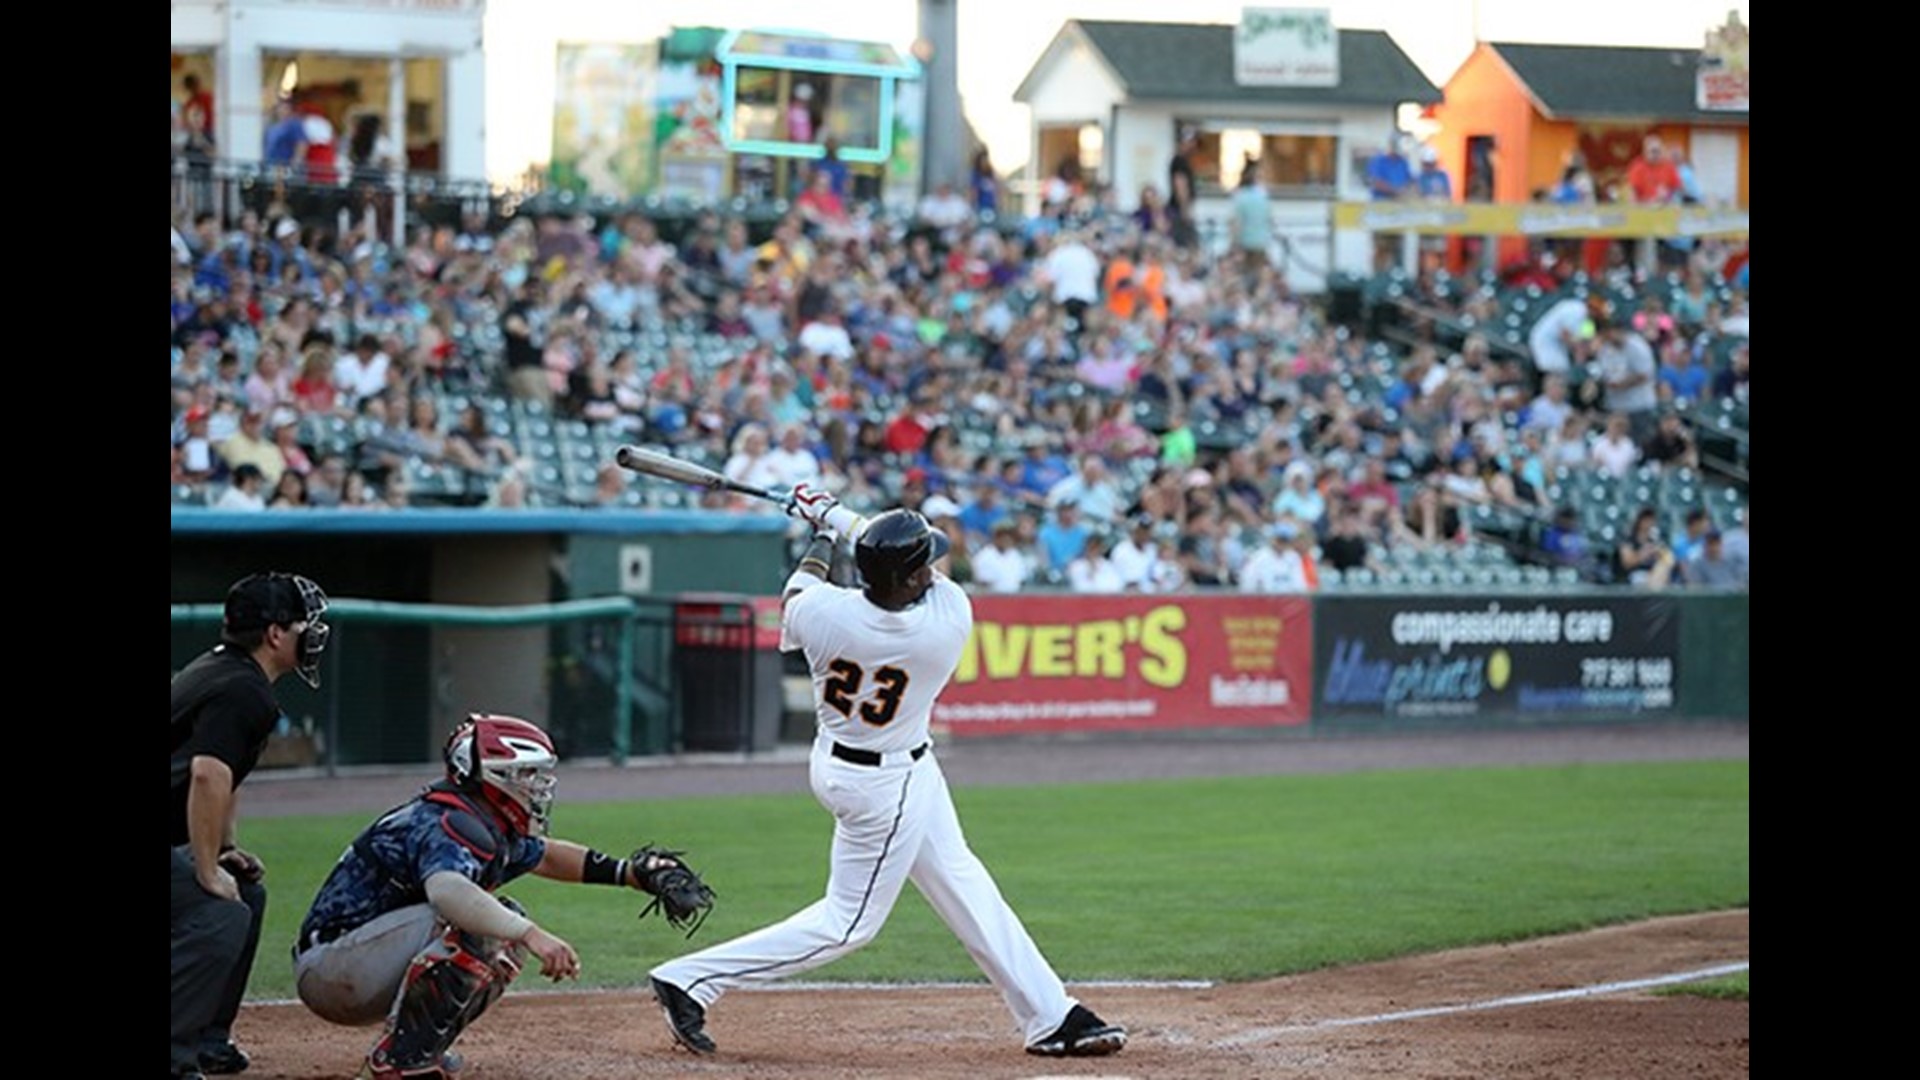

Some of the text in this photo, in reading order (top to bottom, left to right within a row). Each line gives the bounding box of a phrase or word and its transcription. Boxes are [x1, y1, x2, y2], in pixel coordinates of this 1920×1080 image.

[1392, 602, 1613, 653] compassionate care
[822, 657, 910, 727] 23
